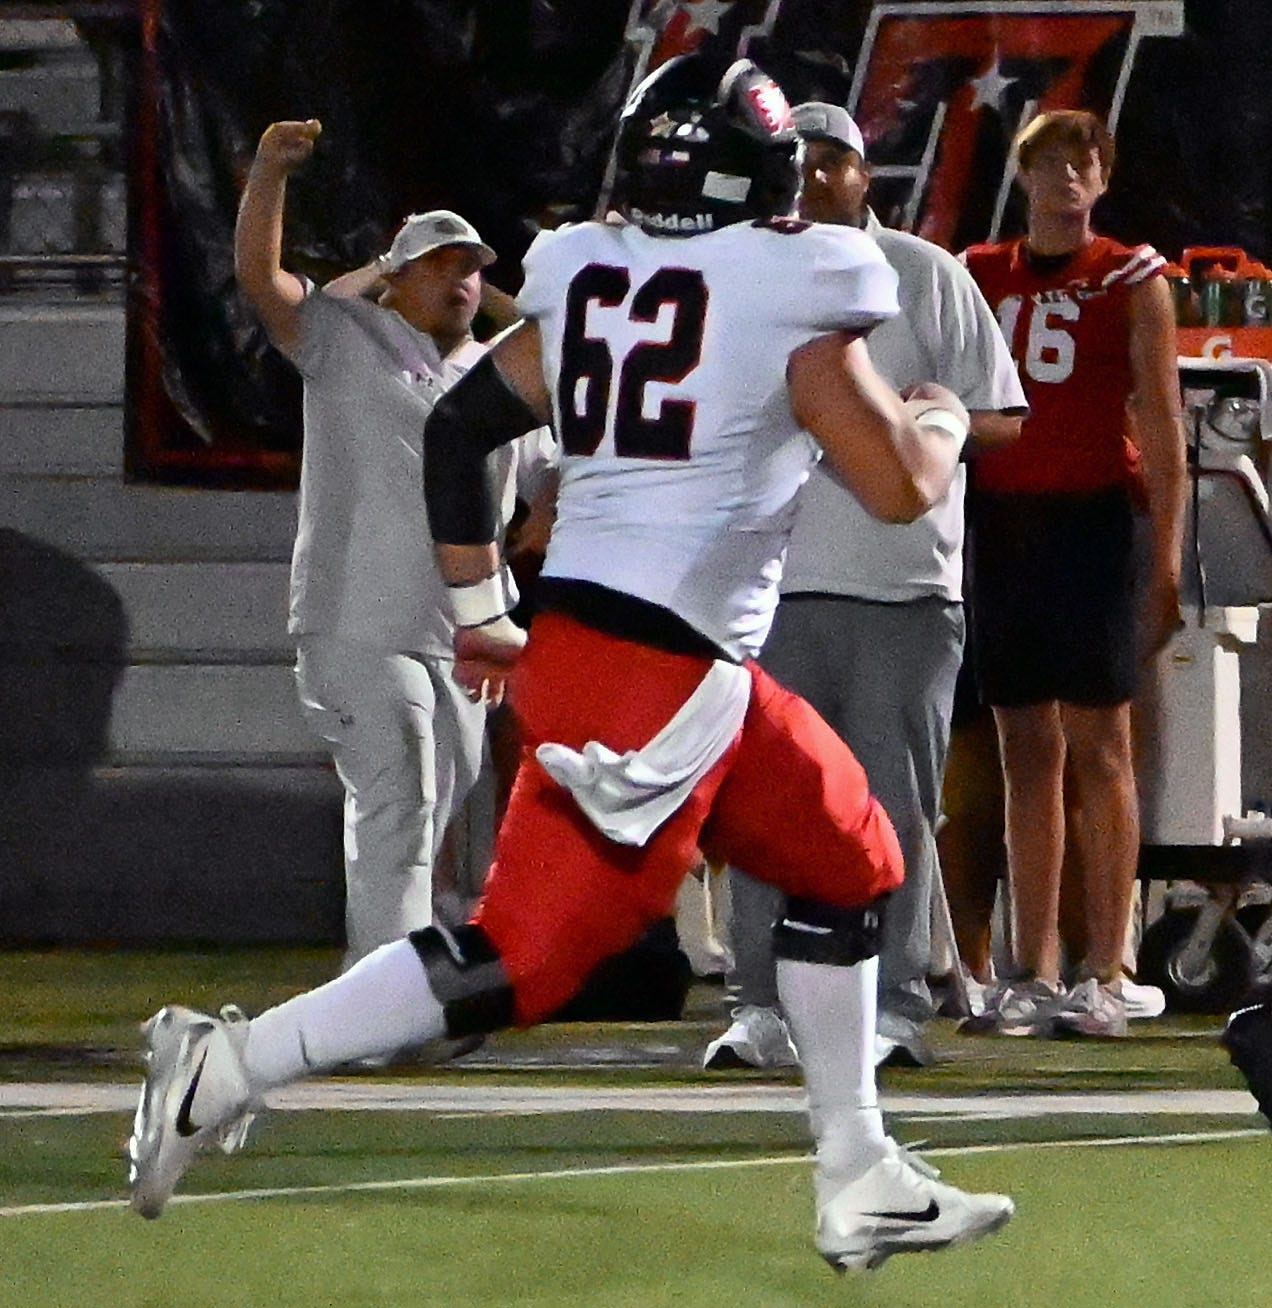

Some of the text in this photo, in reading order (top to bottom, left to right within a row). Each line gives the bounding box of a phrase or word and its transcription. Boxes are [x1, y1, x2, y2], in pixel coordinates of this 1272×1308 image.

[557, 261, 710, 461] 62
[996, 293, 1081, 384] 16
[1201, 335, 1233, 361] G
